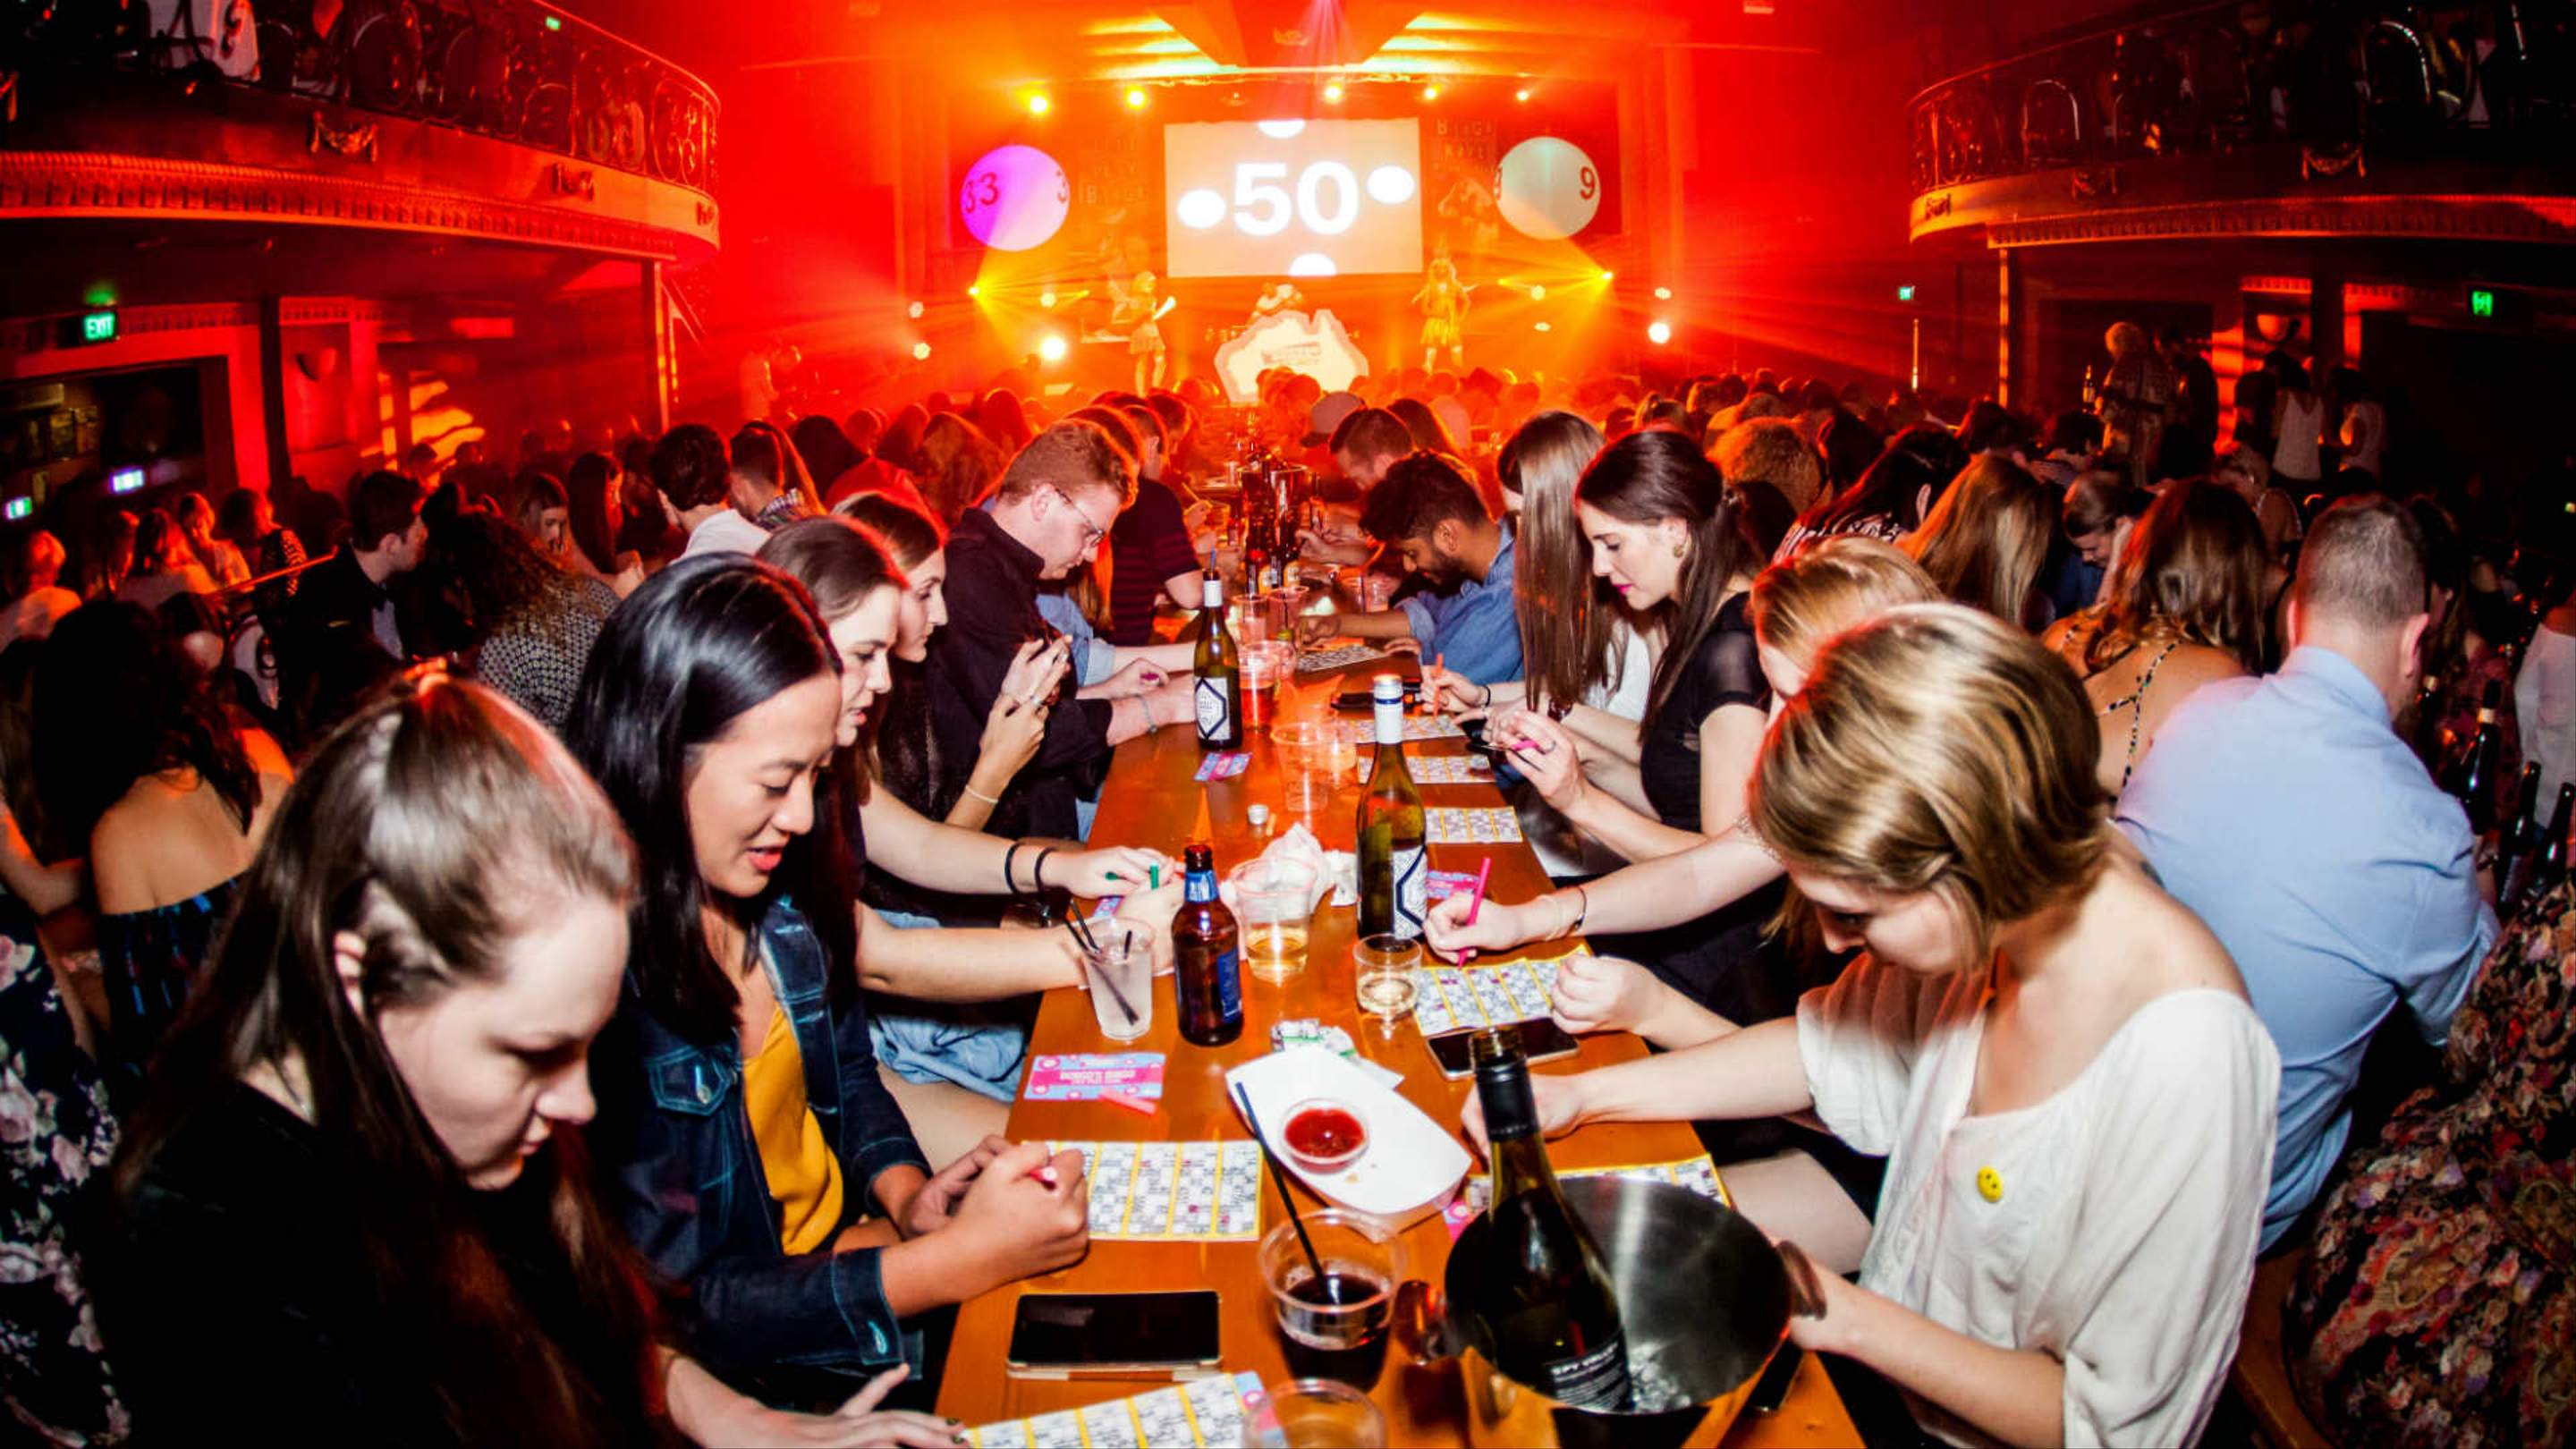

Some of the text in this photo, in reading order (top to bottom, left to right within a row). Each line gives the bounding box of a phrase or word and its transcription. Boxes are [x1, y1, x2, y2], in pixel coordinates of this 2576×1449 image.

[1233, 159, 1361, 238] 50
[1579, 165, 1596, 200] 9
[86, 315, 114, 340] EXIT
